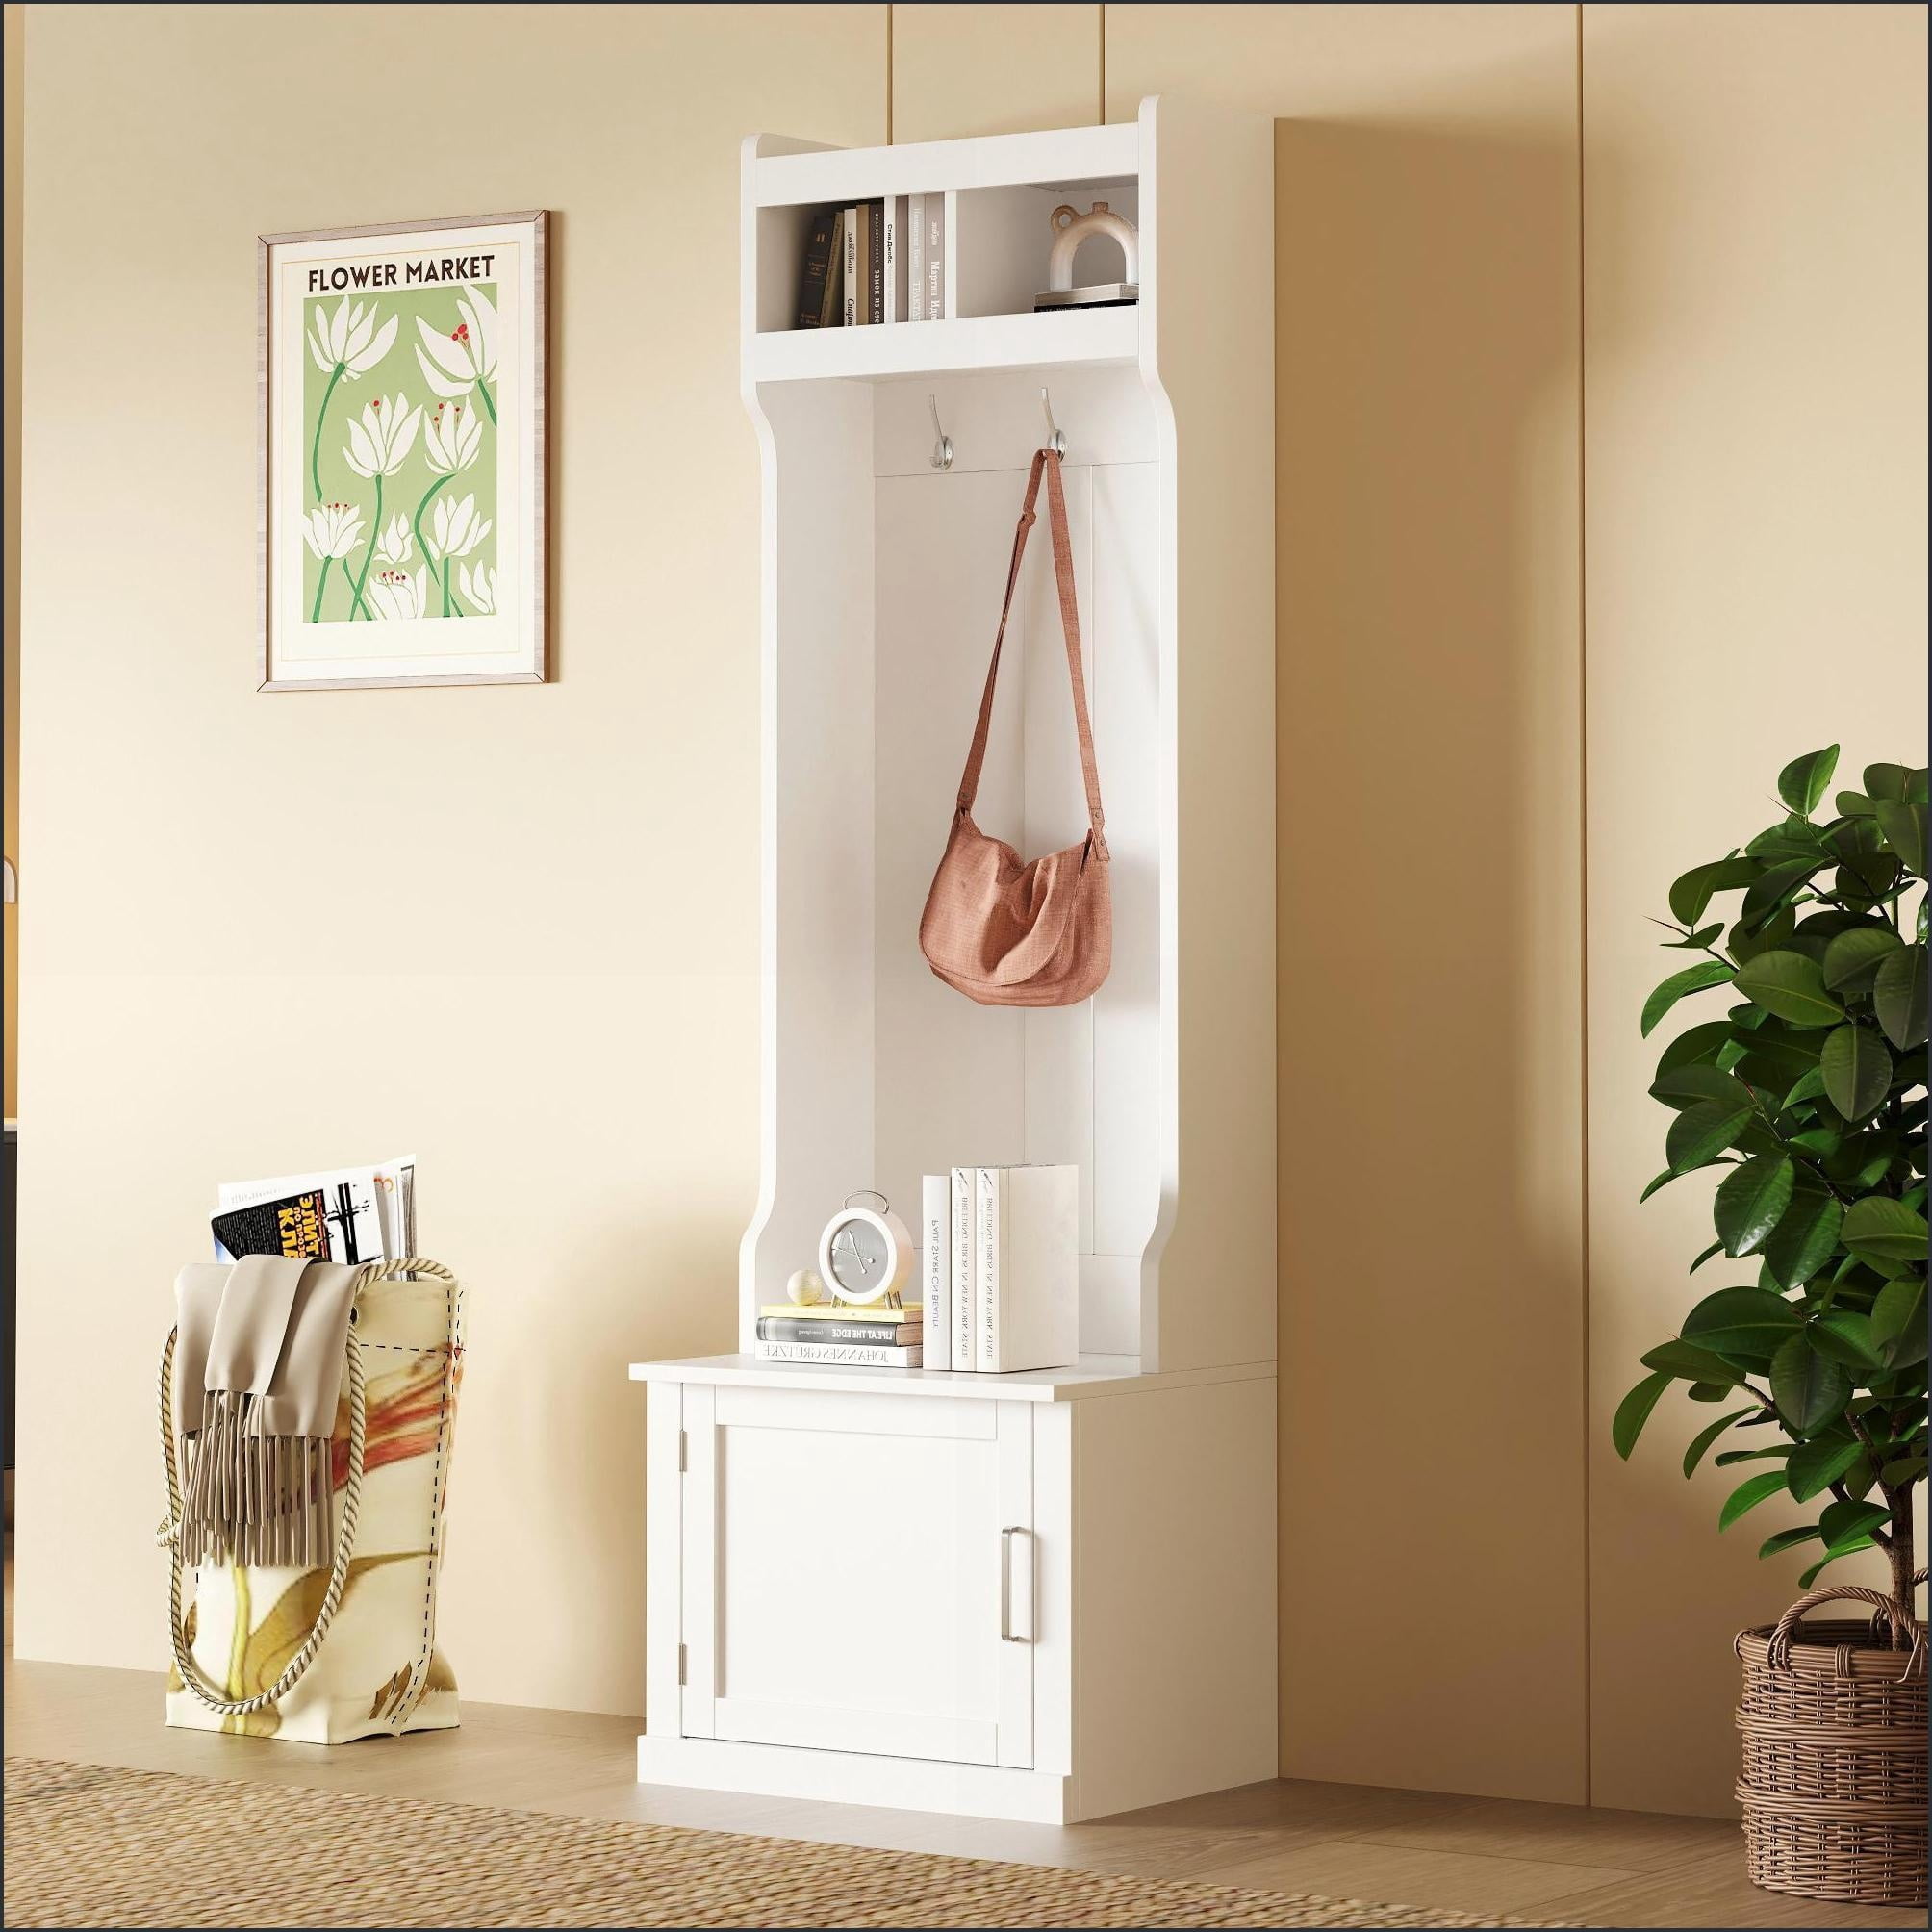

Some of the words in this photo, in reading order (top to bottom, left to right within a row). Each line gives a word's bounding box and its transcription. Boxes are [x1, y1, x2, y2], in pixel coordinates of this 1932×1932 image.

[309, 264, 397, 292] FLOWER
[406, 255, 495, 284] MARKET
[928, 261, 940, 296] Мартин
[293, 1206, 302, 1222] ПО
[299, 1194, 319, 1255] ЭЛИТ
